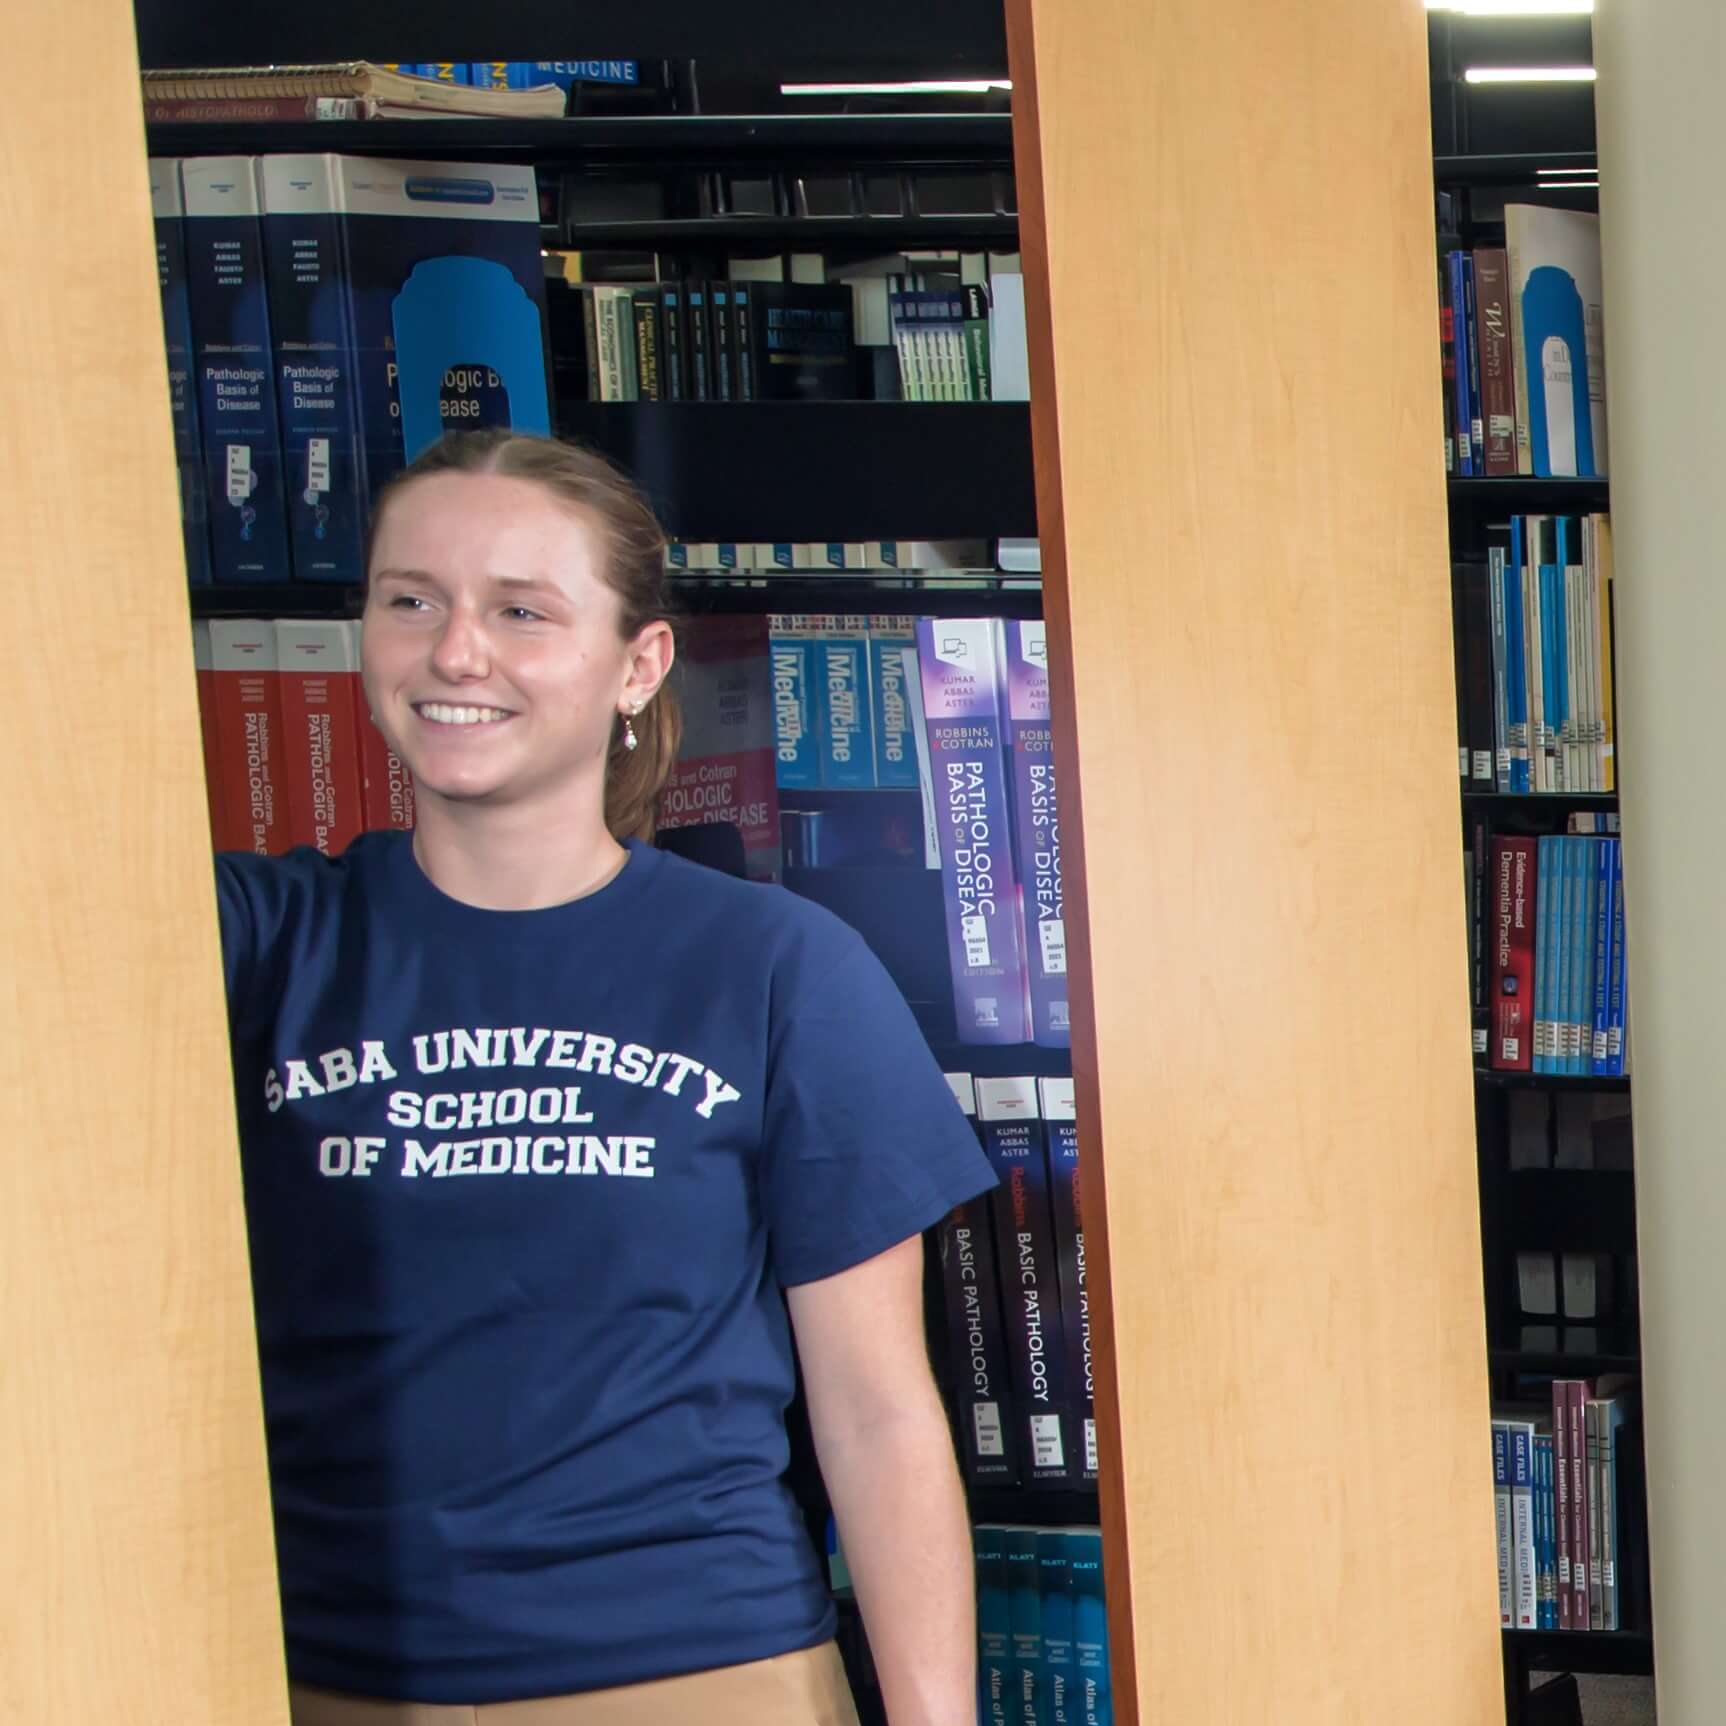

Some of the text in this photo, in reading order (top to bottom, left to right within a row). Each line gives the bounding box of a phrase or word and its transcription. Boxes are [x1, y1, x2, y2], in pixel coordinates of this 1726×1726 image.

[537, 61, 634, 81] MEDICINE
[206, 367, 265, 381] Pathologic
[283, 365, 340, 379] Pathologic
[293, 381, 334, 394] Basis of
[216, 383, 259, 396] Basis of
[217, 398, 261, 411] Disease
[293, 396, 335, 410] Disease
[944, 688, 975, 697] ABBAS
[936, 727, 989, 738] ROBBINS
[941, 737, 994, 749] COTRAN
[245, 712, 265, 819] PATHOLOGIC
[308, 714, 327, 821] PATHOLOGIC
[947, 763, 968, 843] BASIS OF
[1029, 764, 1049, 826] BASIS
[966, 761, 996, 915] PATHOLOGIC
[1515, 851, 1527, 928] Evidence-based
[1499, 851, 1513, 968] Dementia Practice
[264, 1027, 742, 1119] SABA UNIVERSITY
[387, 1086, 595, 1130] SCHOOL
[997, 1127, 1030, 1136] KUMAR
[1000, 1138, 1030, 1147] ABBAS
[319, 1136, 656, 1178] OF MEDICINE
[1001, 1148, 1030, 1157] ASTER
[956, 1228, 977, 1281] BASIC
[1017, 1232, 1036, 1285] BASIC
[964, 1285, 991, 1398] PATHOLOGY
[1023, 1290, 1049, 1402] PATHOLOGY
[1495, 1434, 1505, 1481] CASE FILES
[1516, 1435, 1526, 1481] CASE FILES
[1558, 1459, 1567, 1503] Essentials
[1573, 1459, 1583, 1503] Essentials
[1518, 1499, 1528, 1545] INTERNAL
[990, 1668, 1001, 1697] Atlas
[1023, 1669, 1032, 1699] Atlas
[1054, 1674, 1064, 1705] Atlas
[1086, 1678, 1097, 1709] Atlas
[992, 1702, 1001, 1717] of
[1024, 1704, 1033, 1718] of
[1055, 1710, 1064, 1724] of
